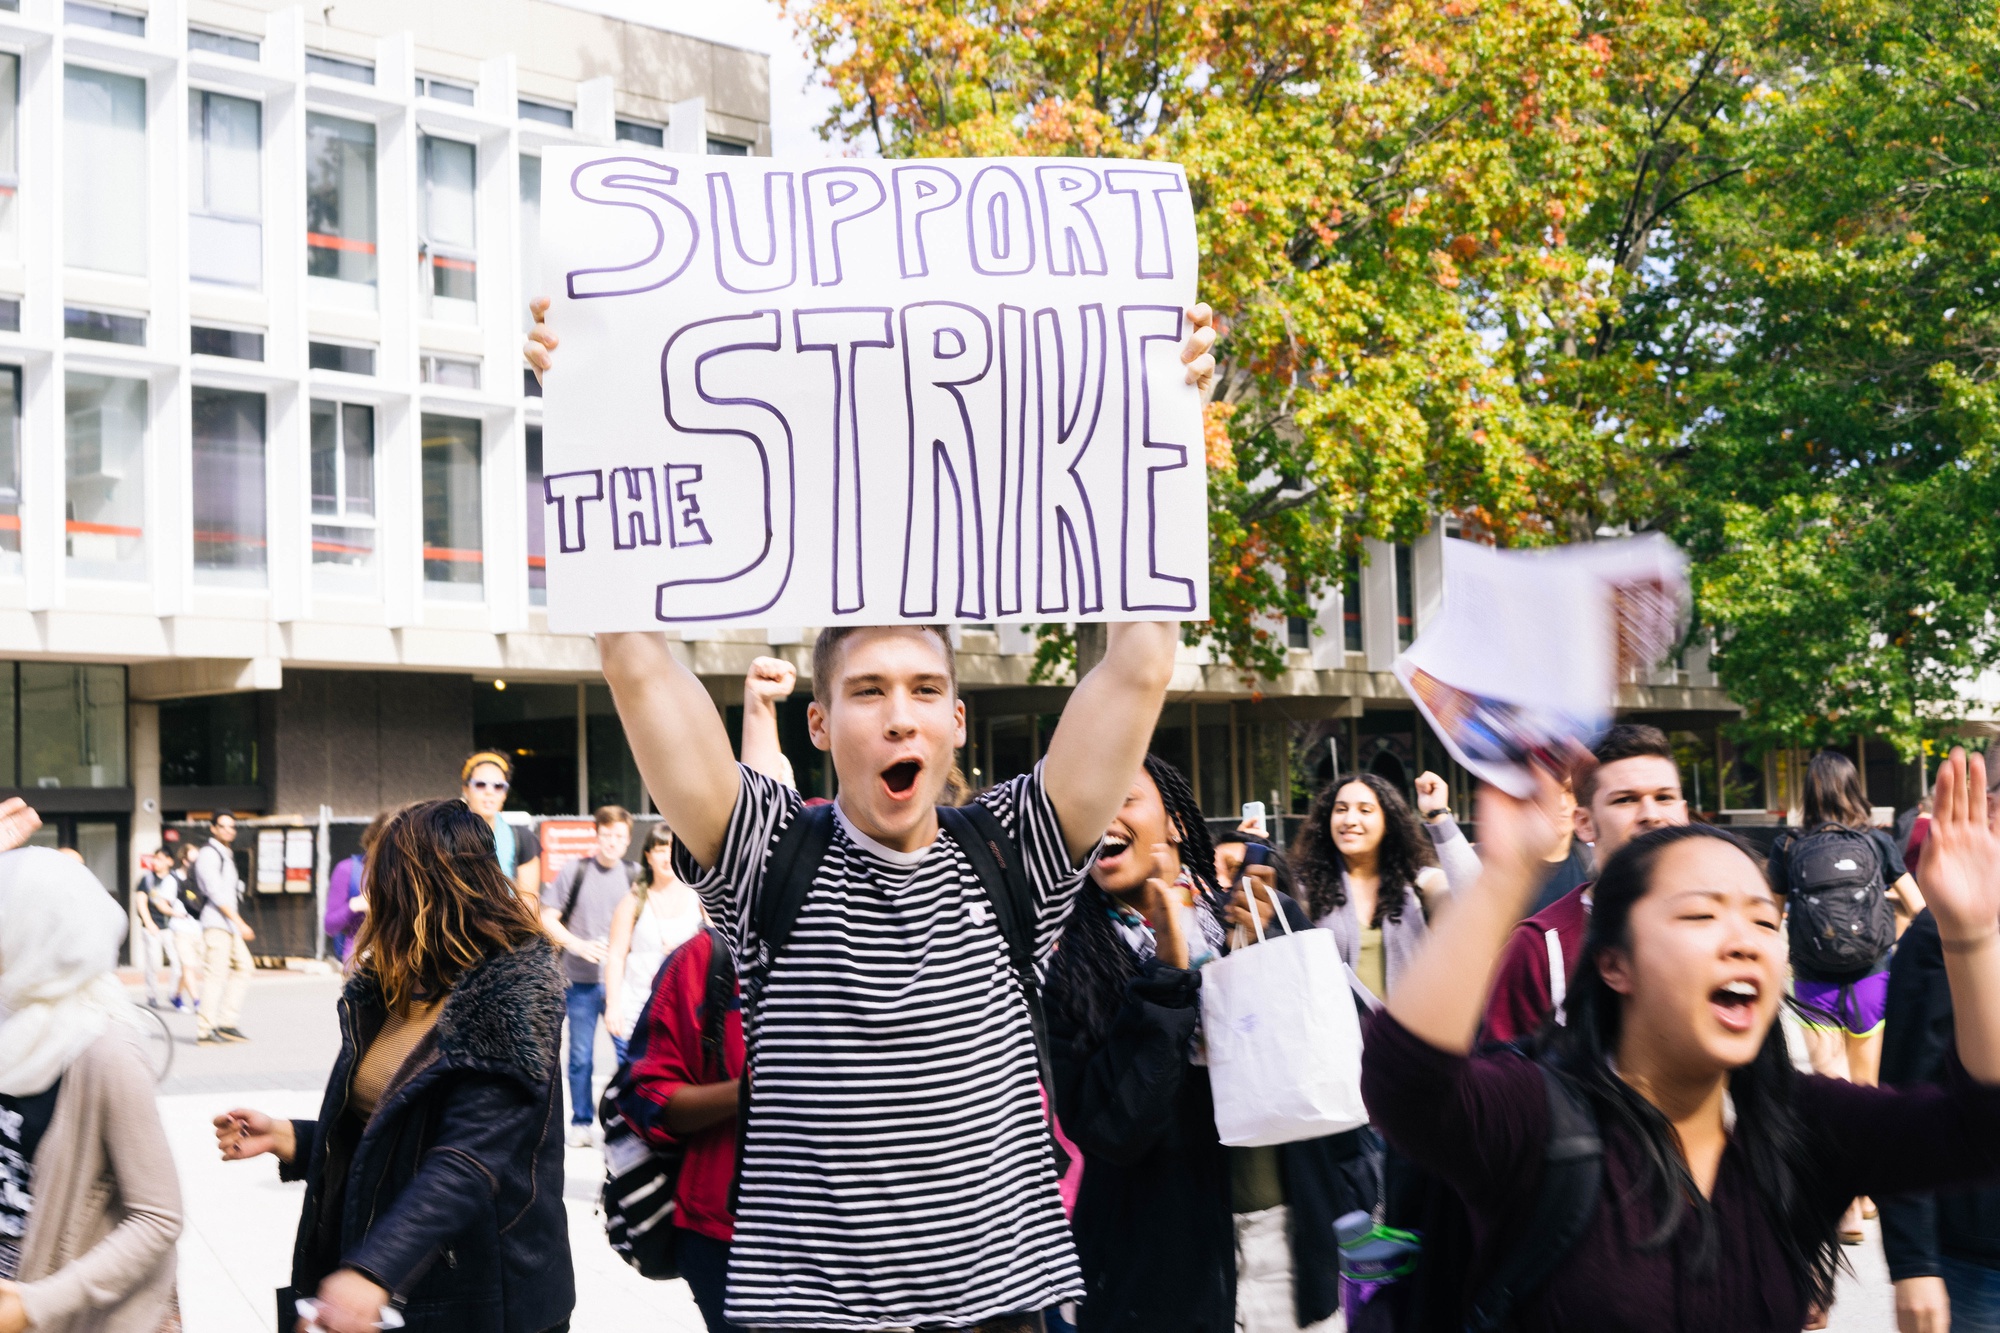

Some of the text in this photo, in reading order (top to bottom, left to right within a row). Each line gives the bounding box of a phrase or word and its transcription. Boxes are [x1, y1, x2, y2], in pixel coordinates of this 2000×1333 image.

[567, 157, 1183, 298] SUPPORT
[545, 302, 1196, 621] THE STRIKE
